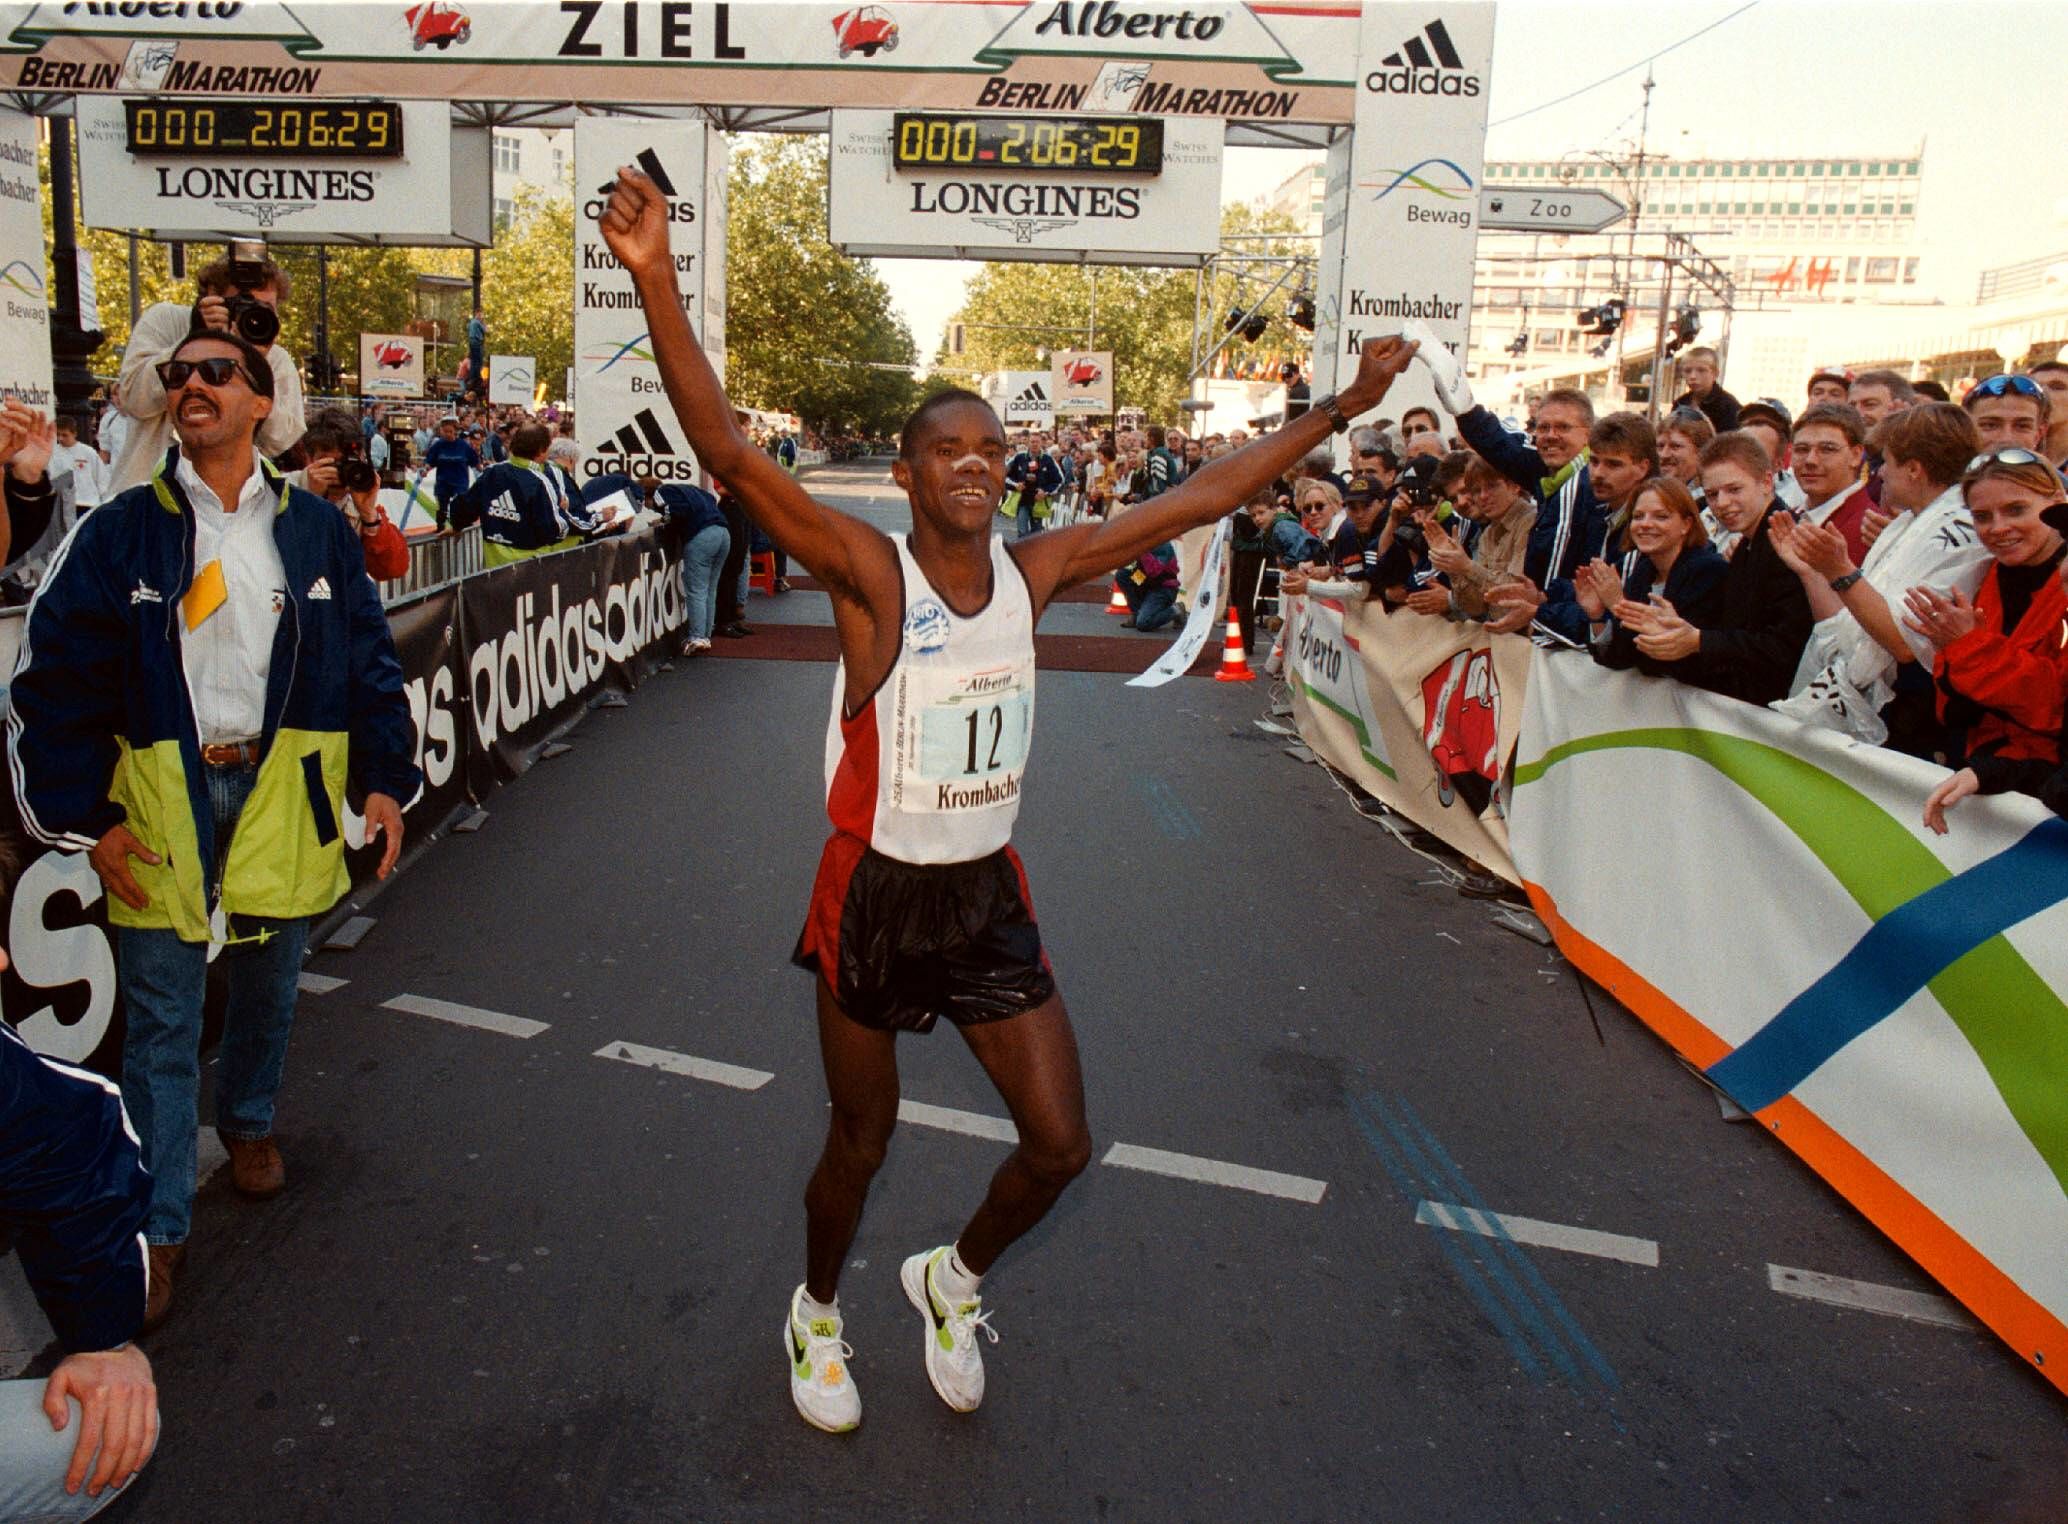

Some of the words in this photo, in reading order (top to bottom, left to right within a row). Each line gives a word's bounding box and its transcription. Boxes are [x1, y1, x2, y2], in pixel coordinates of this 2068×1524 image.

[558, 2, 746, 59] ZIEL
[1035, 1, 1223, 40] Alberto
[17, 56, 121, 90] BERLIN
[164, 60, 321, 93] MARATHON
[1366, 67, 1480, 97] adidas
[976, 77, 1088, 110] BERLIN
[1133, 82, 1298, 117] MARATHON
[156, 167, 375, 202] LONGINES
[910, 182, 1141, 219] LONGINES
[1408, 205, 1471, 229] Bewag
[1530, 199, 1572, 217] Zoo
[7, 301, 46, 325] Bewag
[1349, 289, 1463, 320] Krombacher
[584, 453, 692, 481] adidas
[470, 583, 606, 752] adidas
[604, 548, 689, 663] adidas
[963, 704, 1003, 775] 12
[936, 772, 1021, 810] Krombach
